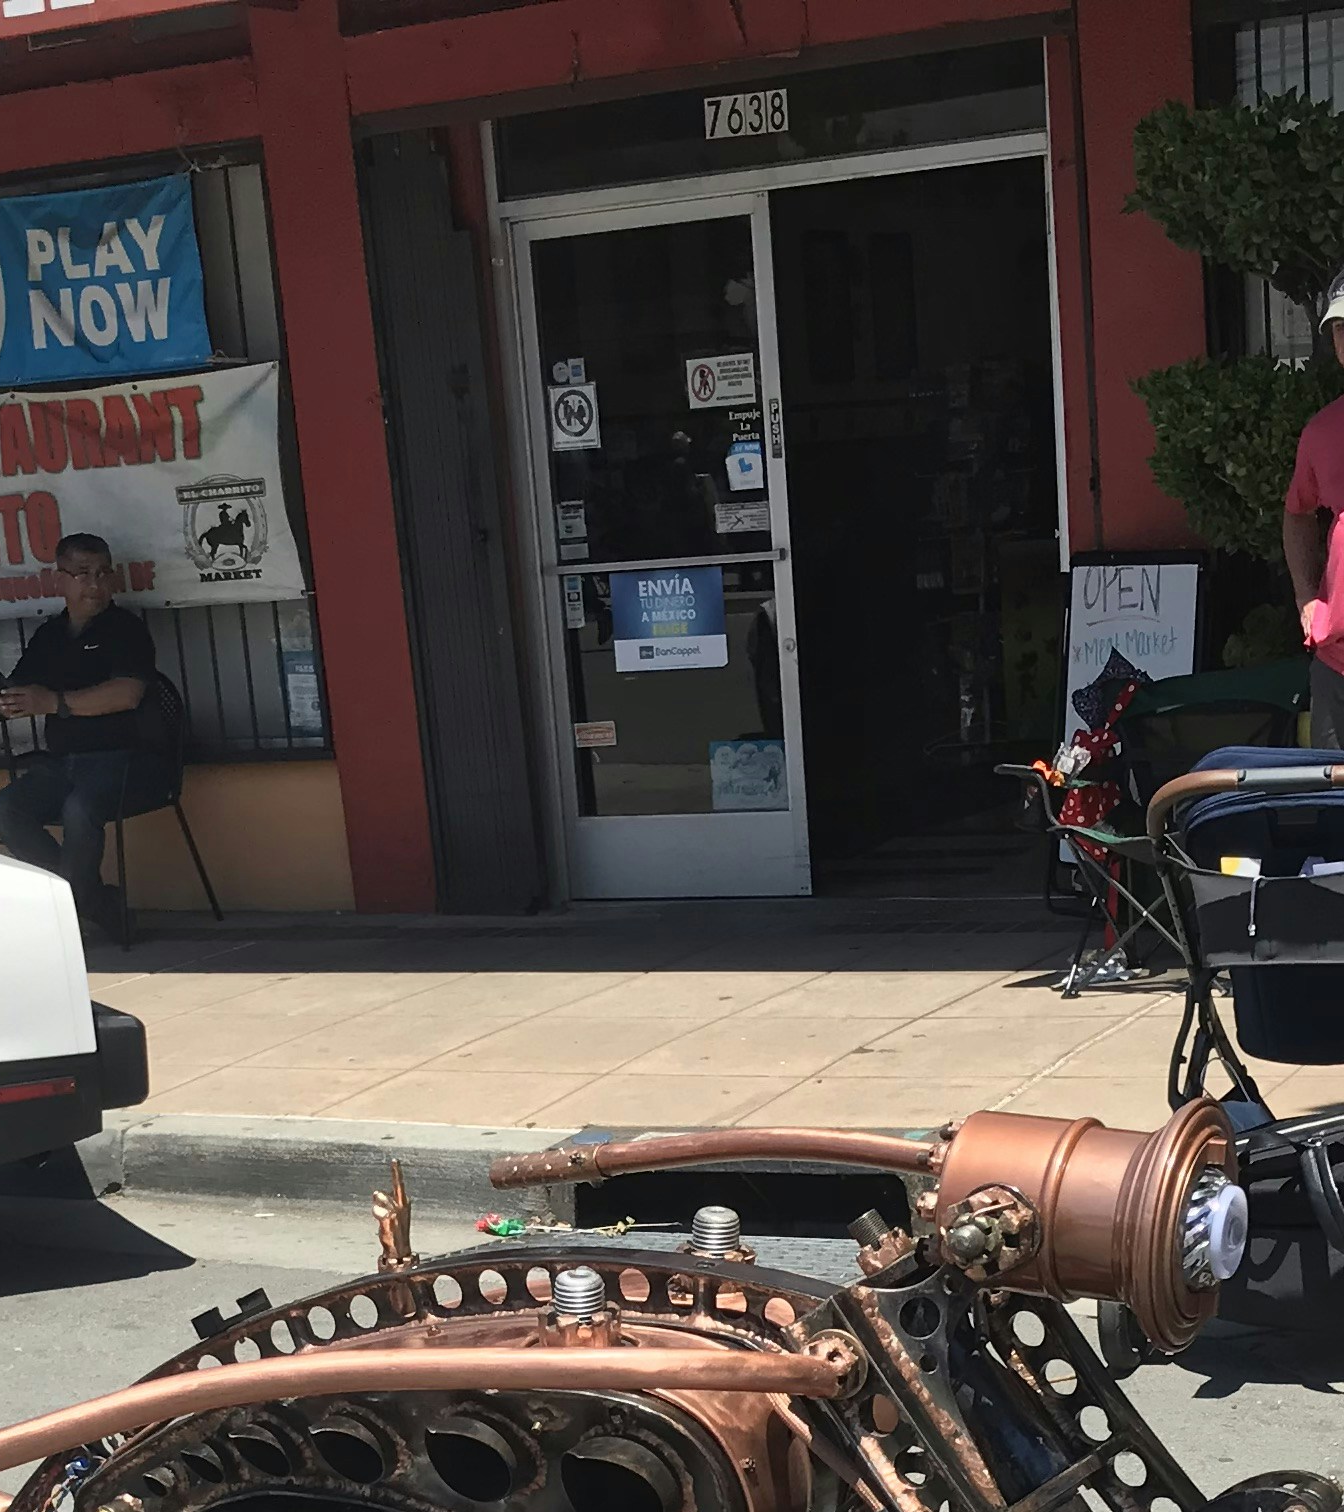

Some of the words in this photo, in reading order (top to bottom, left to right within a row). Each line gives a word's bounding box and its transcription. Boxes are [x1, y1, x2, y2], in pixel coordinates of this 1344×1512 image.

[707, 92, 786, 137] 7638
[25, 215, 167, 282] PLAY
[26, 277, 171, 350] NOW
[728, 408, 762, 421] Empuje
[770, 402, 781, 446] PUSH
[732, 431, 760, 442] Puerta
[740, 422, 751, 431] La
[199, 569, 263, 583] MARKET
[638, 573, 695, 598] ENVÍA
[1083, 565, 1161, 616] OPEN
[640, 598, 654, 610] TU
[654, 595, 696, 608] DINERO
[641, 611, 650, 622] A
[651, 607, 697, 622] MÉXICO
[1125, 626, 1179, 656] Market
[655, 645, 702, 658] BanCoppel
